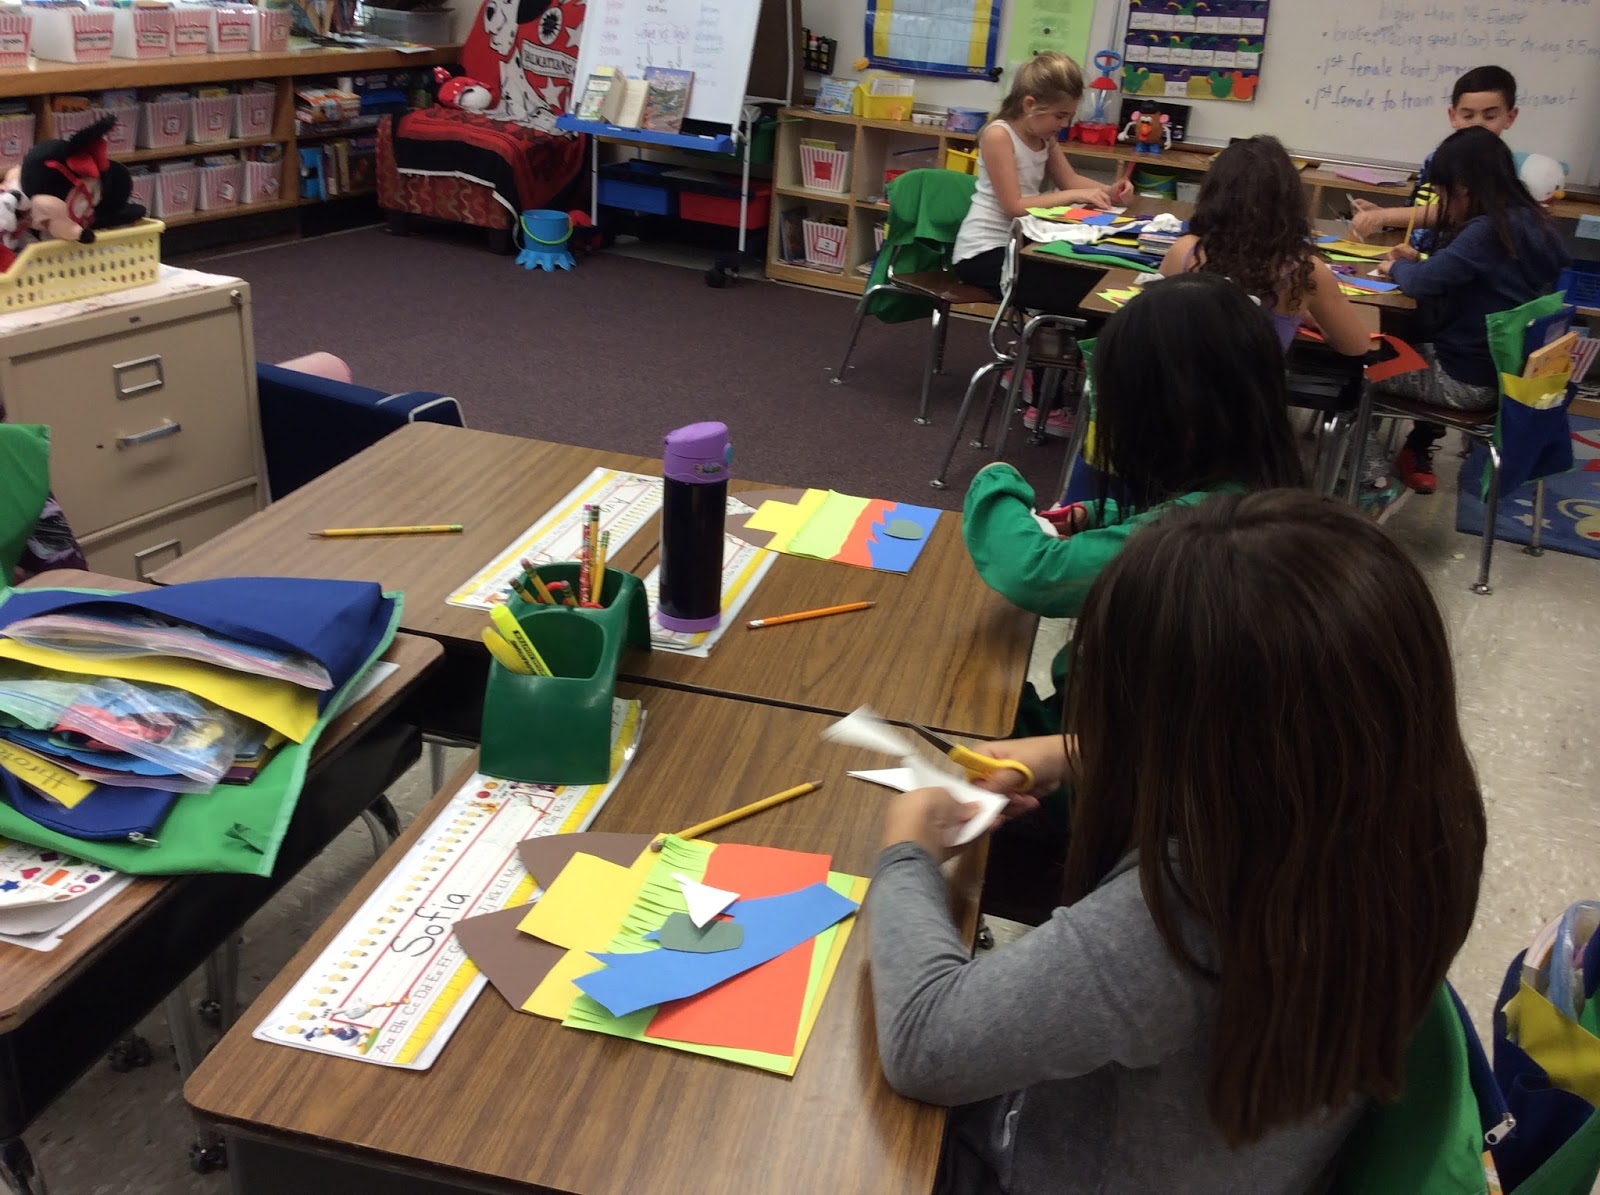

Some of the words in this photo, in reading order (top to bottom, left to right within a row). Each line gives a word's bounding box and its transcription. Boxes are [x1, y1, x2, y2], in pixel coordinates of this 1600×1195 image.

[1347, 52, 1392, 77] female
[1331, 85, 1375, 110] female
[1380, 89, 1397, 111] to
[389, 893, 471, 957] Sofia
[376, 1037, 395, 1054] Aa
[389, 1018, 407, 1036] Bb
[403, 1000, 421, 1016] Cc
[414, 982, 433, 1000] Dd
[436, 955, 452, 968] Ff
